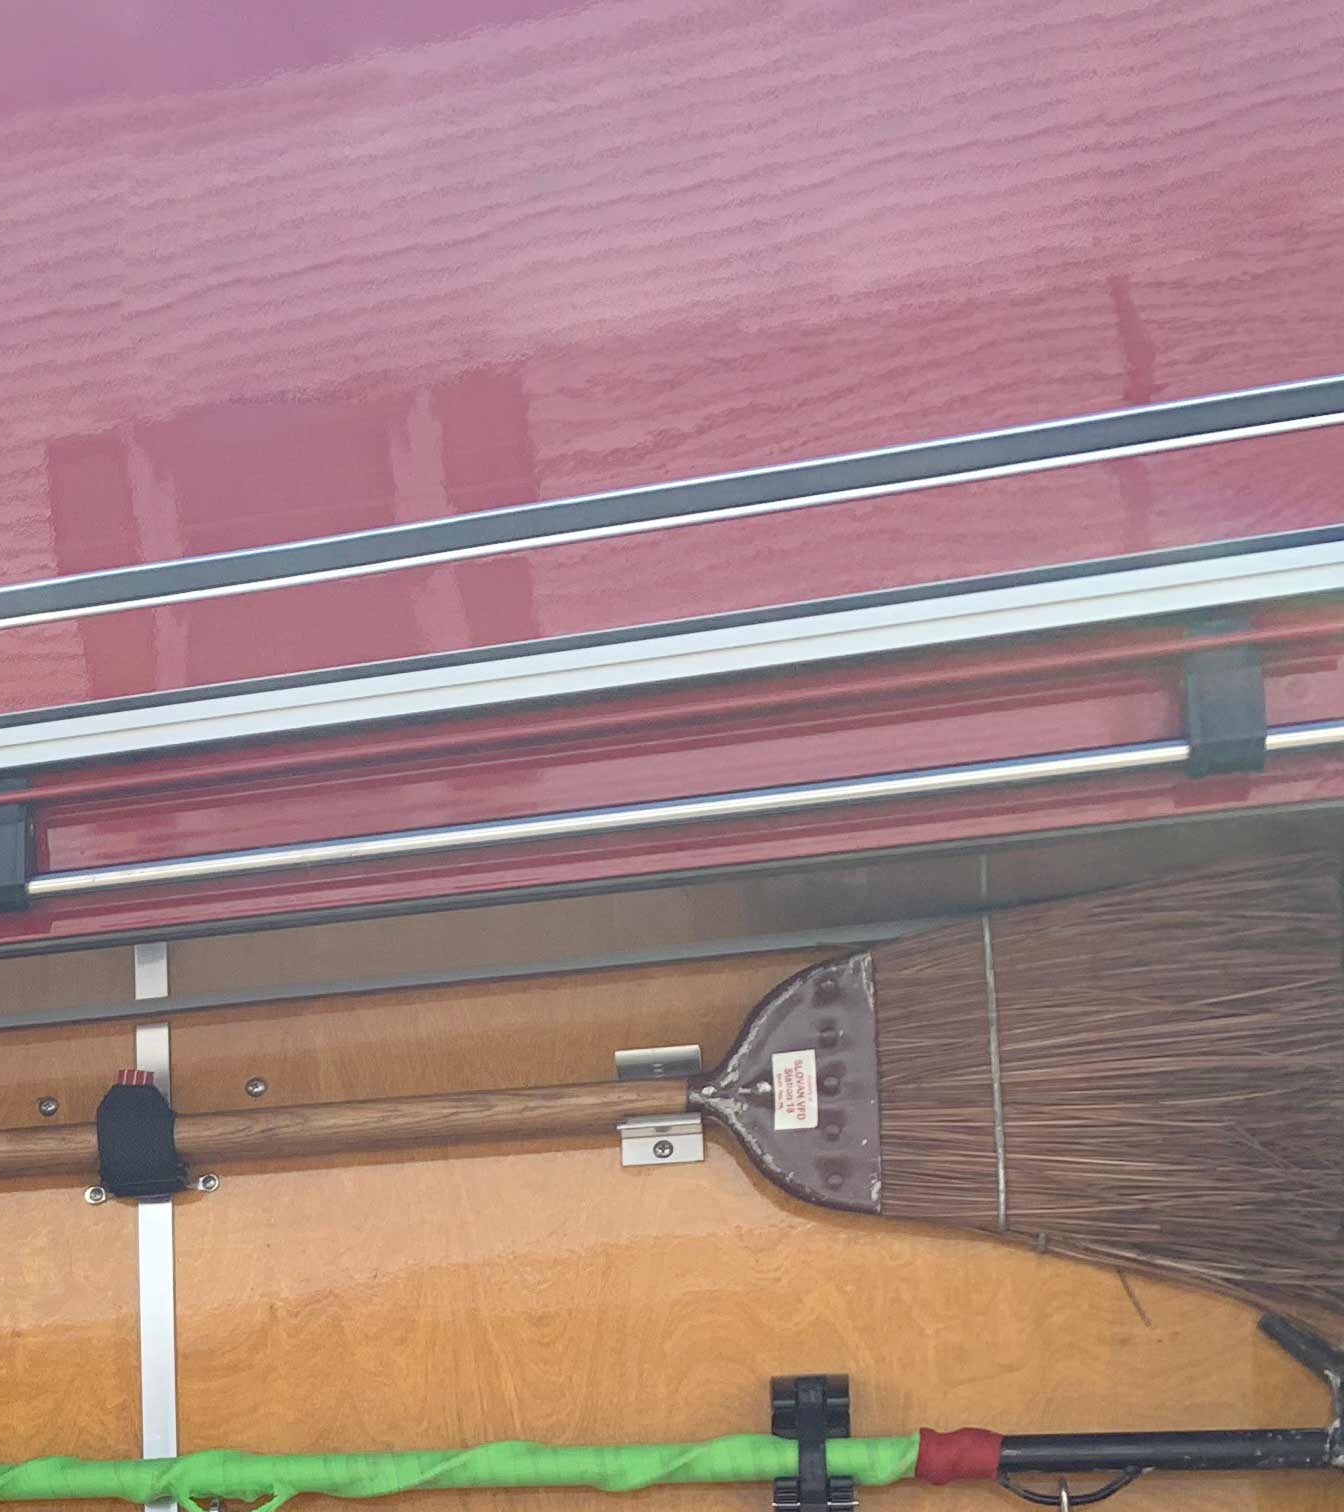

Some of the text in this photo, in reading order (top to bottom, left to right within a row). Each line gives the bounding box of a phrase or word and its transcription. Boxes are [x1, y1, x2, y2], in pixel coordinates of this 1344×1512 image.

[784, 1068, 793, 1100] Station
[794, 1059, 806, 1121] SLOVAN VFD
